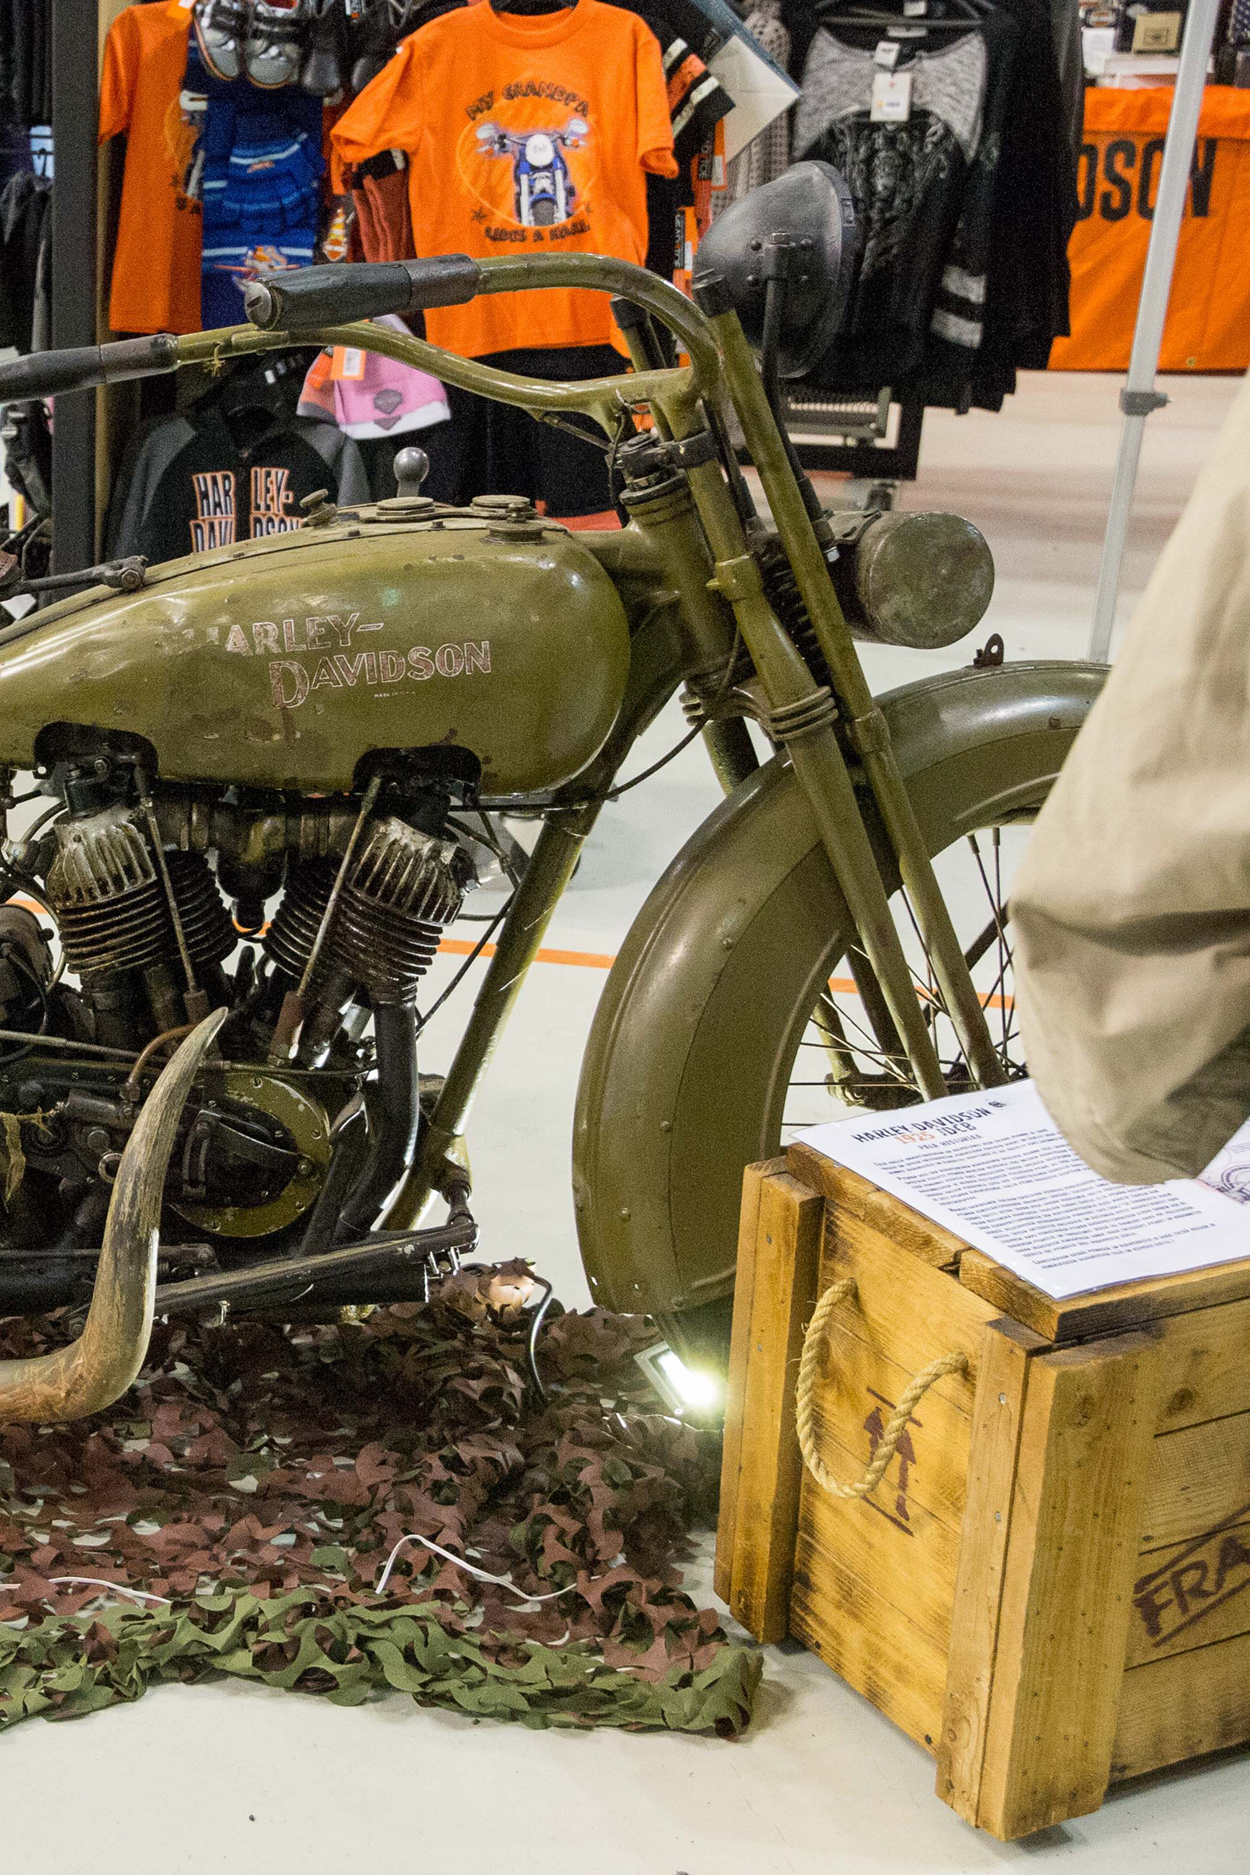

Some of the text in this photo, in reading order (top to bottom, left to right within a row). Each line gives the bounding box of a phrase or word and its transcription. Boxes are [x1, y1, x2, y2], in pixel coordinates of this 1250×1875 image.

[502, 81, 589, 117] GRANDPA
[532, 228, 544, 243] A
[192, 470, 236, 519] HAR
[182, 612, 385, 656] ARLEY-
[268, 640, 492, 709] DAVIDSON
[894, 1131, 936, 1145] 1925
